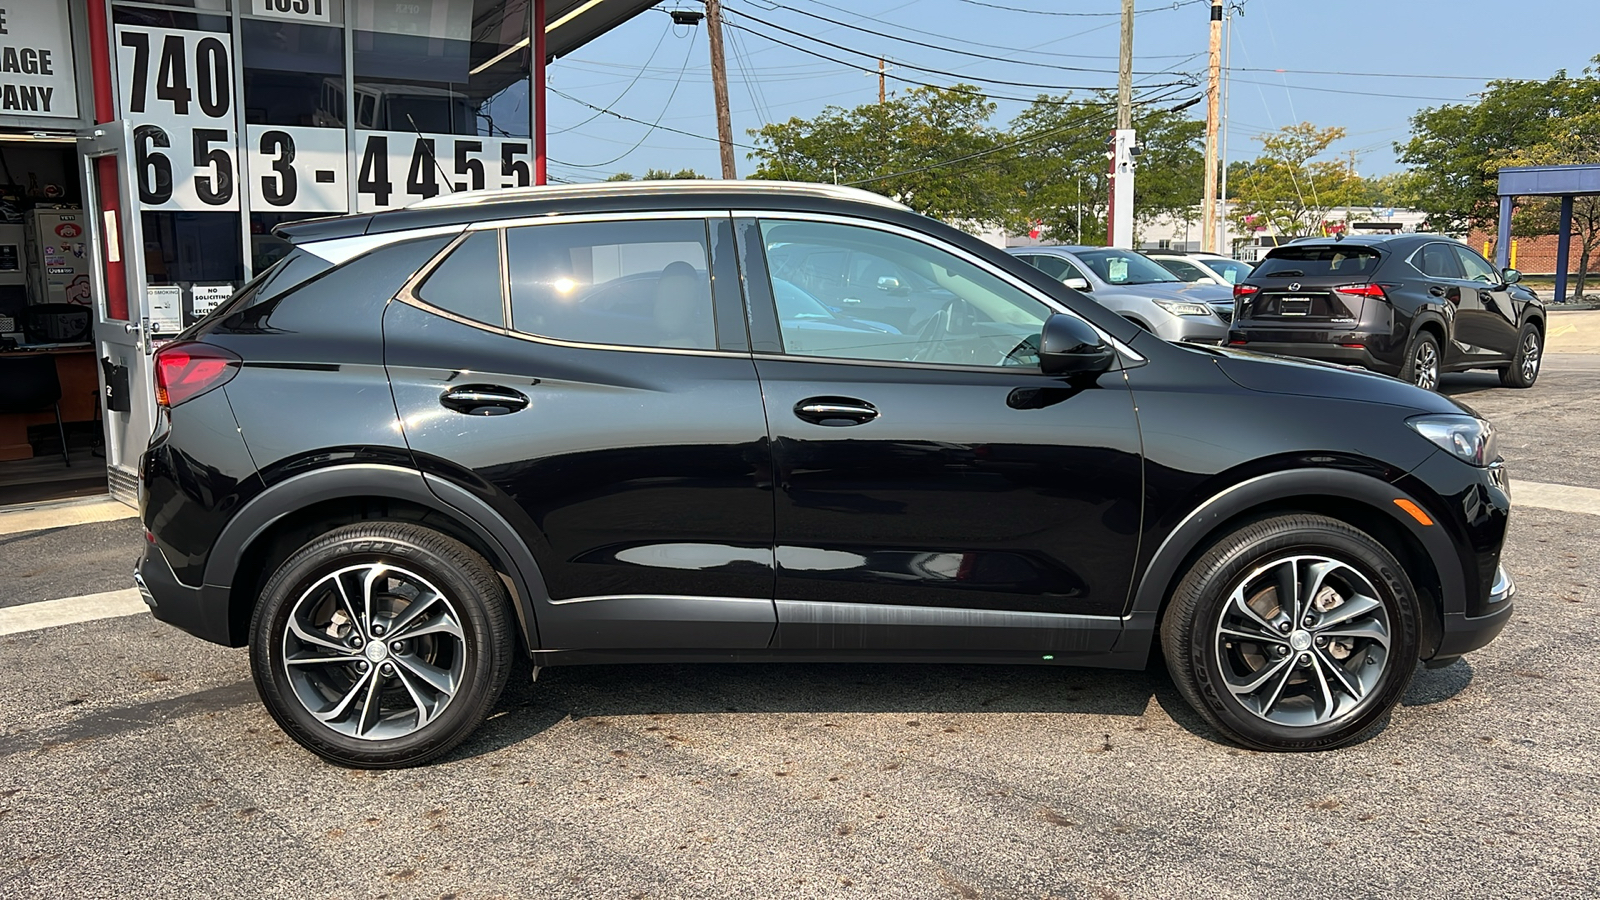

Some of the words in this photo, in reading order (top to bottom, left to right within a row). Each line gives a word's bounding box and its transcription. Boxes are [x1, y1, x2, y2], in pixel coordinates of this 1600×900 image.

[0, 47, 54, 76] AGE
[121, 31, 230, 118] 740
[0, 84, 54, 112] ANY
